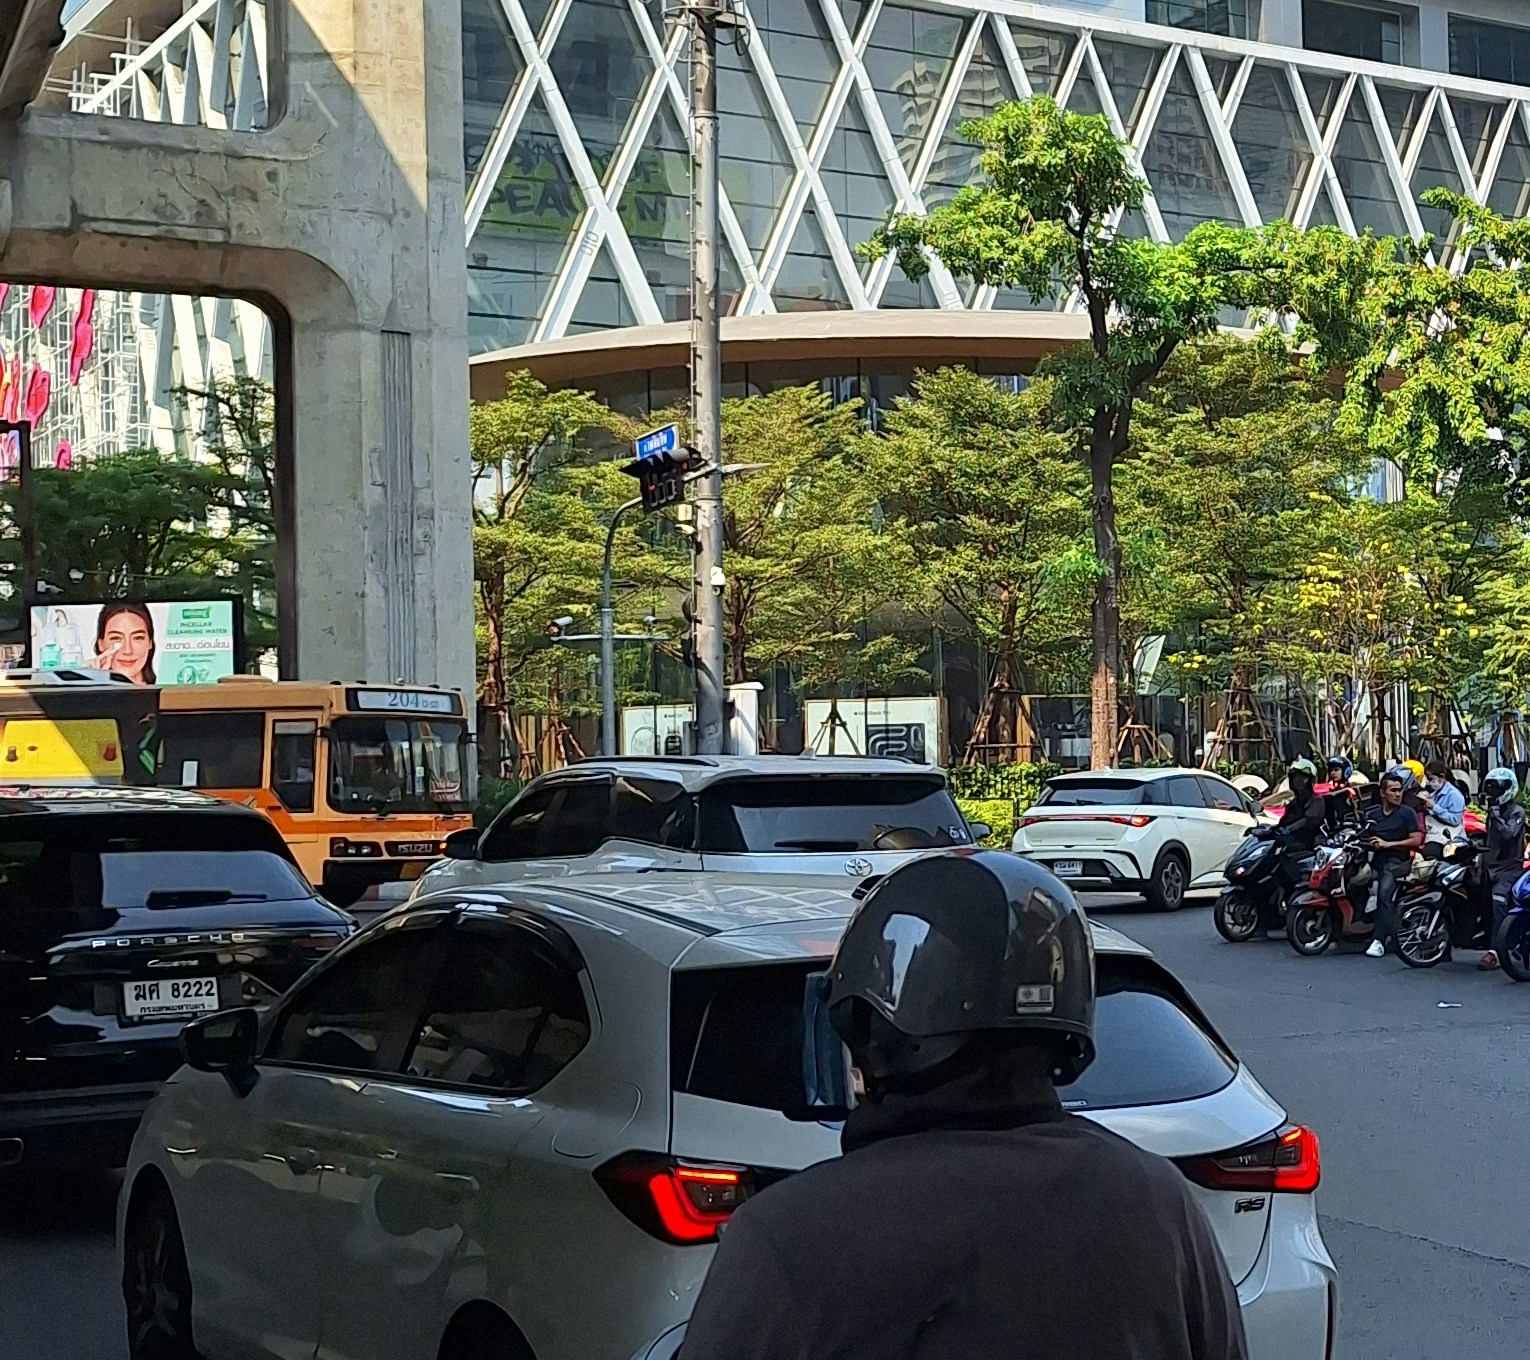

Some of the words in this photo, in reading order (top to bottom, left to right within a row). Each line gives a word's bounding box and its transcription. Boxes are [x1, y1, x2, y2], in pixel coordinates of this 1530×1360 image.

[388, 692, 420, 708] 204
[398, 843, 433, 854] ISUZU
[92, 933, 245, 949] PORSCHE
[171, 979, 216, 999] 8222
[1234, 1196, 1266, 1213] RS
